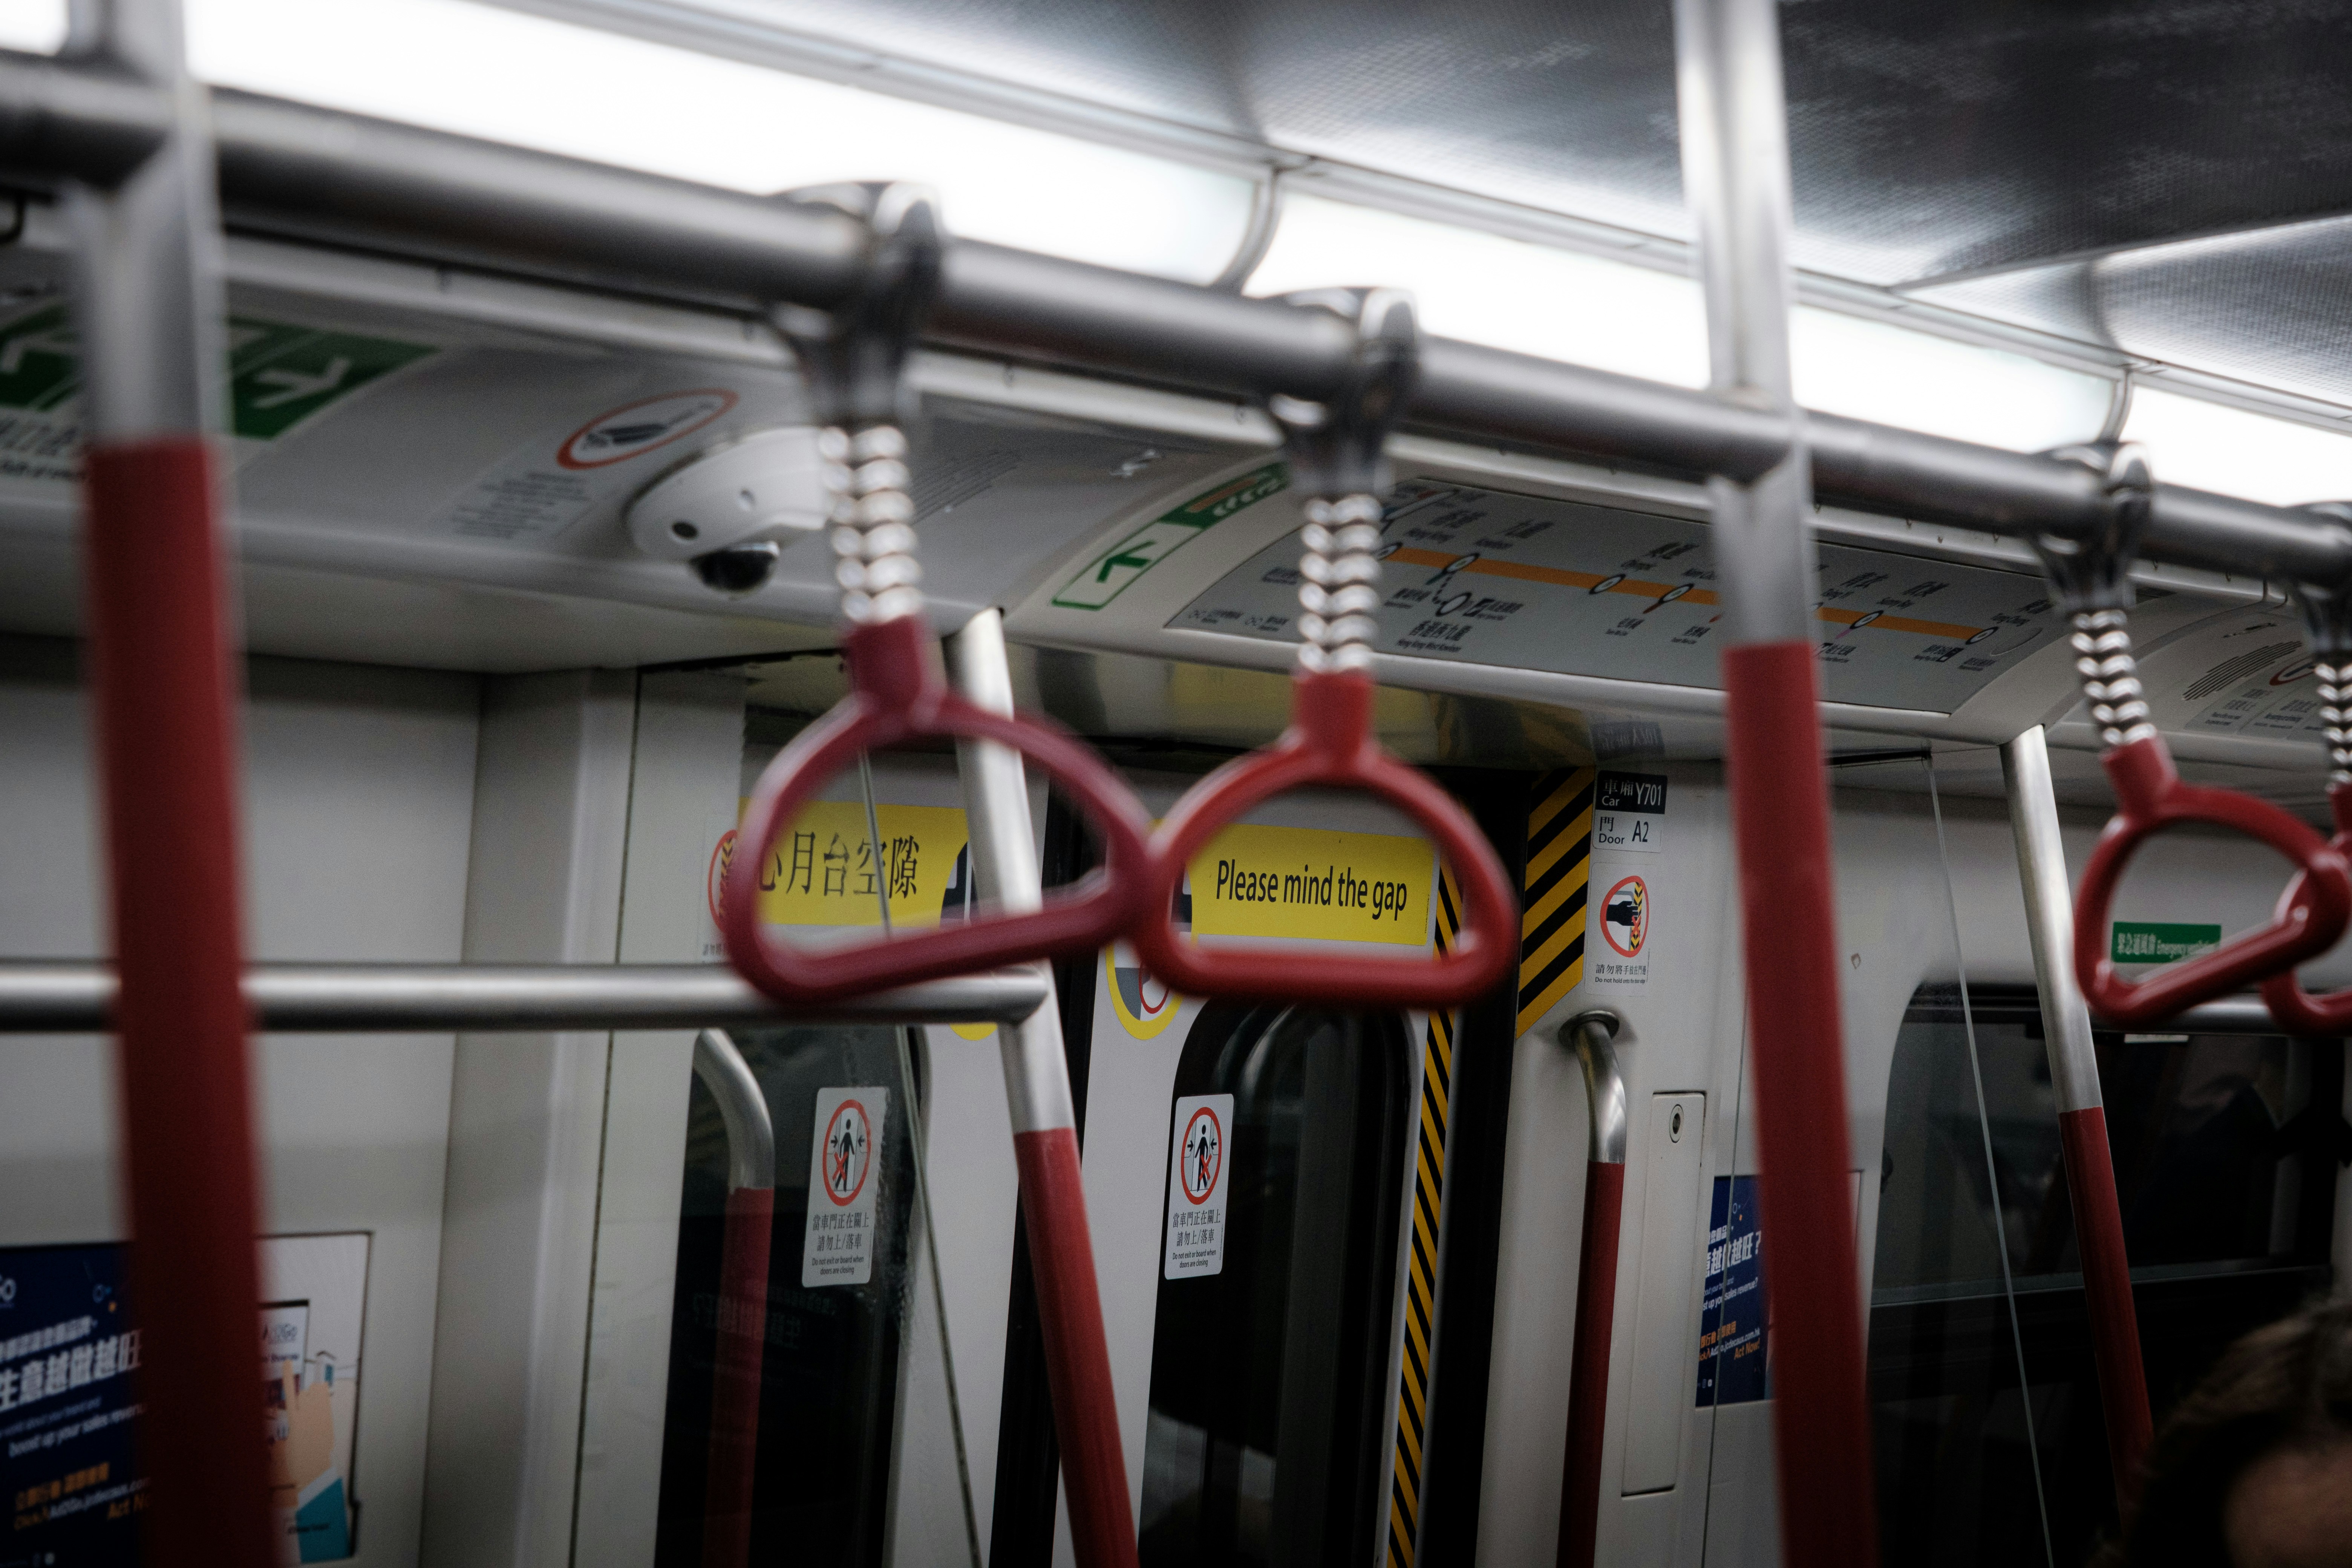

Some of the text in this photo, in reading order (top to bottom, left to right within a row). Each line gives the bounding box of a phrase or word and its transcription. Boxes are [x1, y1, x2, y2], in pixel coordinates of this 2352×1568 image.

[1603, 779, 1634, 796] 車廂
[1635, 782, 1661, 805] Y701
[1602, 796, 1620, 806] Car
[1600, 816, 1614, 832] 門
[1632, 820, 1649, 842] A2
[1599, 833, 1625, 844] Door
[1216, 859, 1279, 902] Please
[1283, 864, 1334, 906] mind
[1337, 867, 1368, 908] the
[1372, 881, 1407, 921] gap
[813, 1212, 869, 1231] 當車門正在關上
[1173, 1209, 1220, 1228] 當車門正在關上
[1176, 1228, 1214, 1246] 請勿上/落車
[812, 1257, 818, 1266] Do
[1196, 1259, 1208, 1267] closing
[840, 1266, 854, 1274] closing
[1724, 1288, 1737, 1301] sales
[1734, 1345, 1744, 1360] Act
